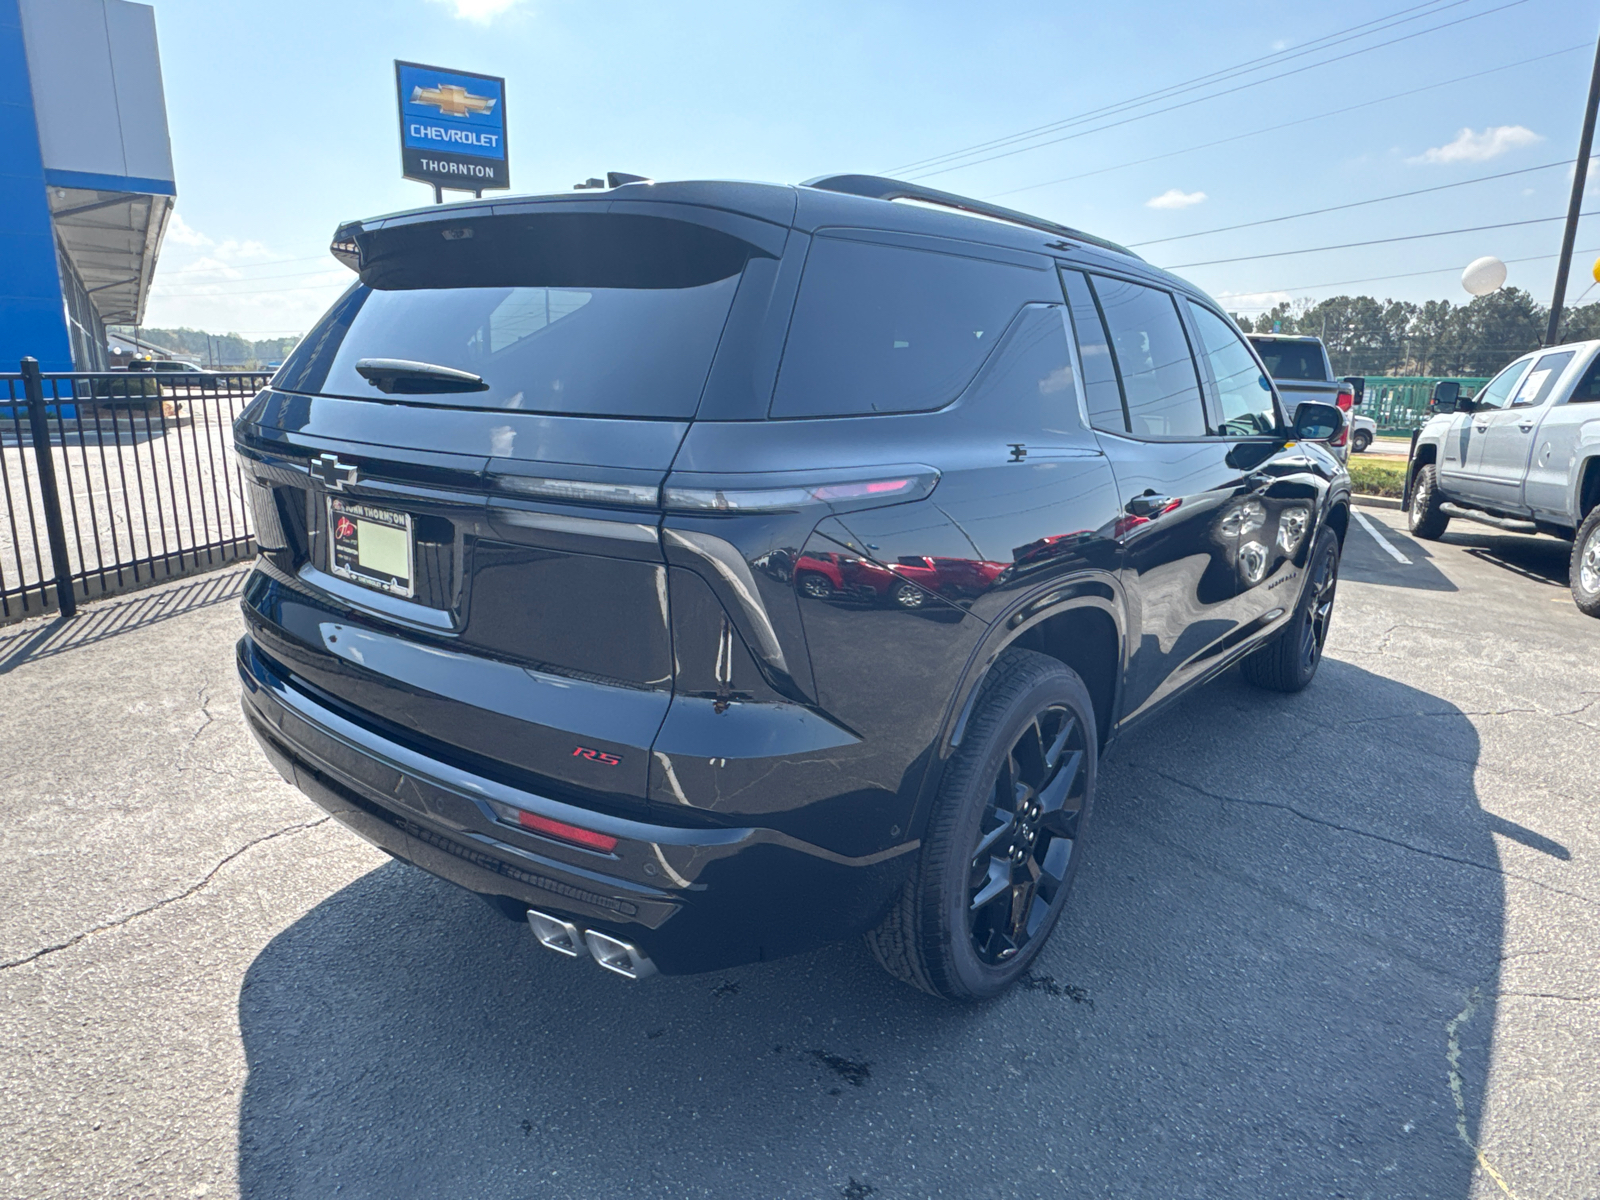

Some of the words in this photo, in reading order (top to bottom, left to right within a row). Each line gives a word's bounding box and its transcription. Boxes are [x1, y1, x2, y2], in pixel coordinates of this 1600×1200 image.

[410, 124, 498, 147] CHEVROLET
[420, 159, 494, 178] THORNTON
[572, 746, 622, 766] RS
